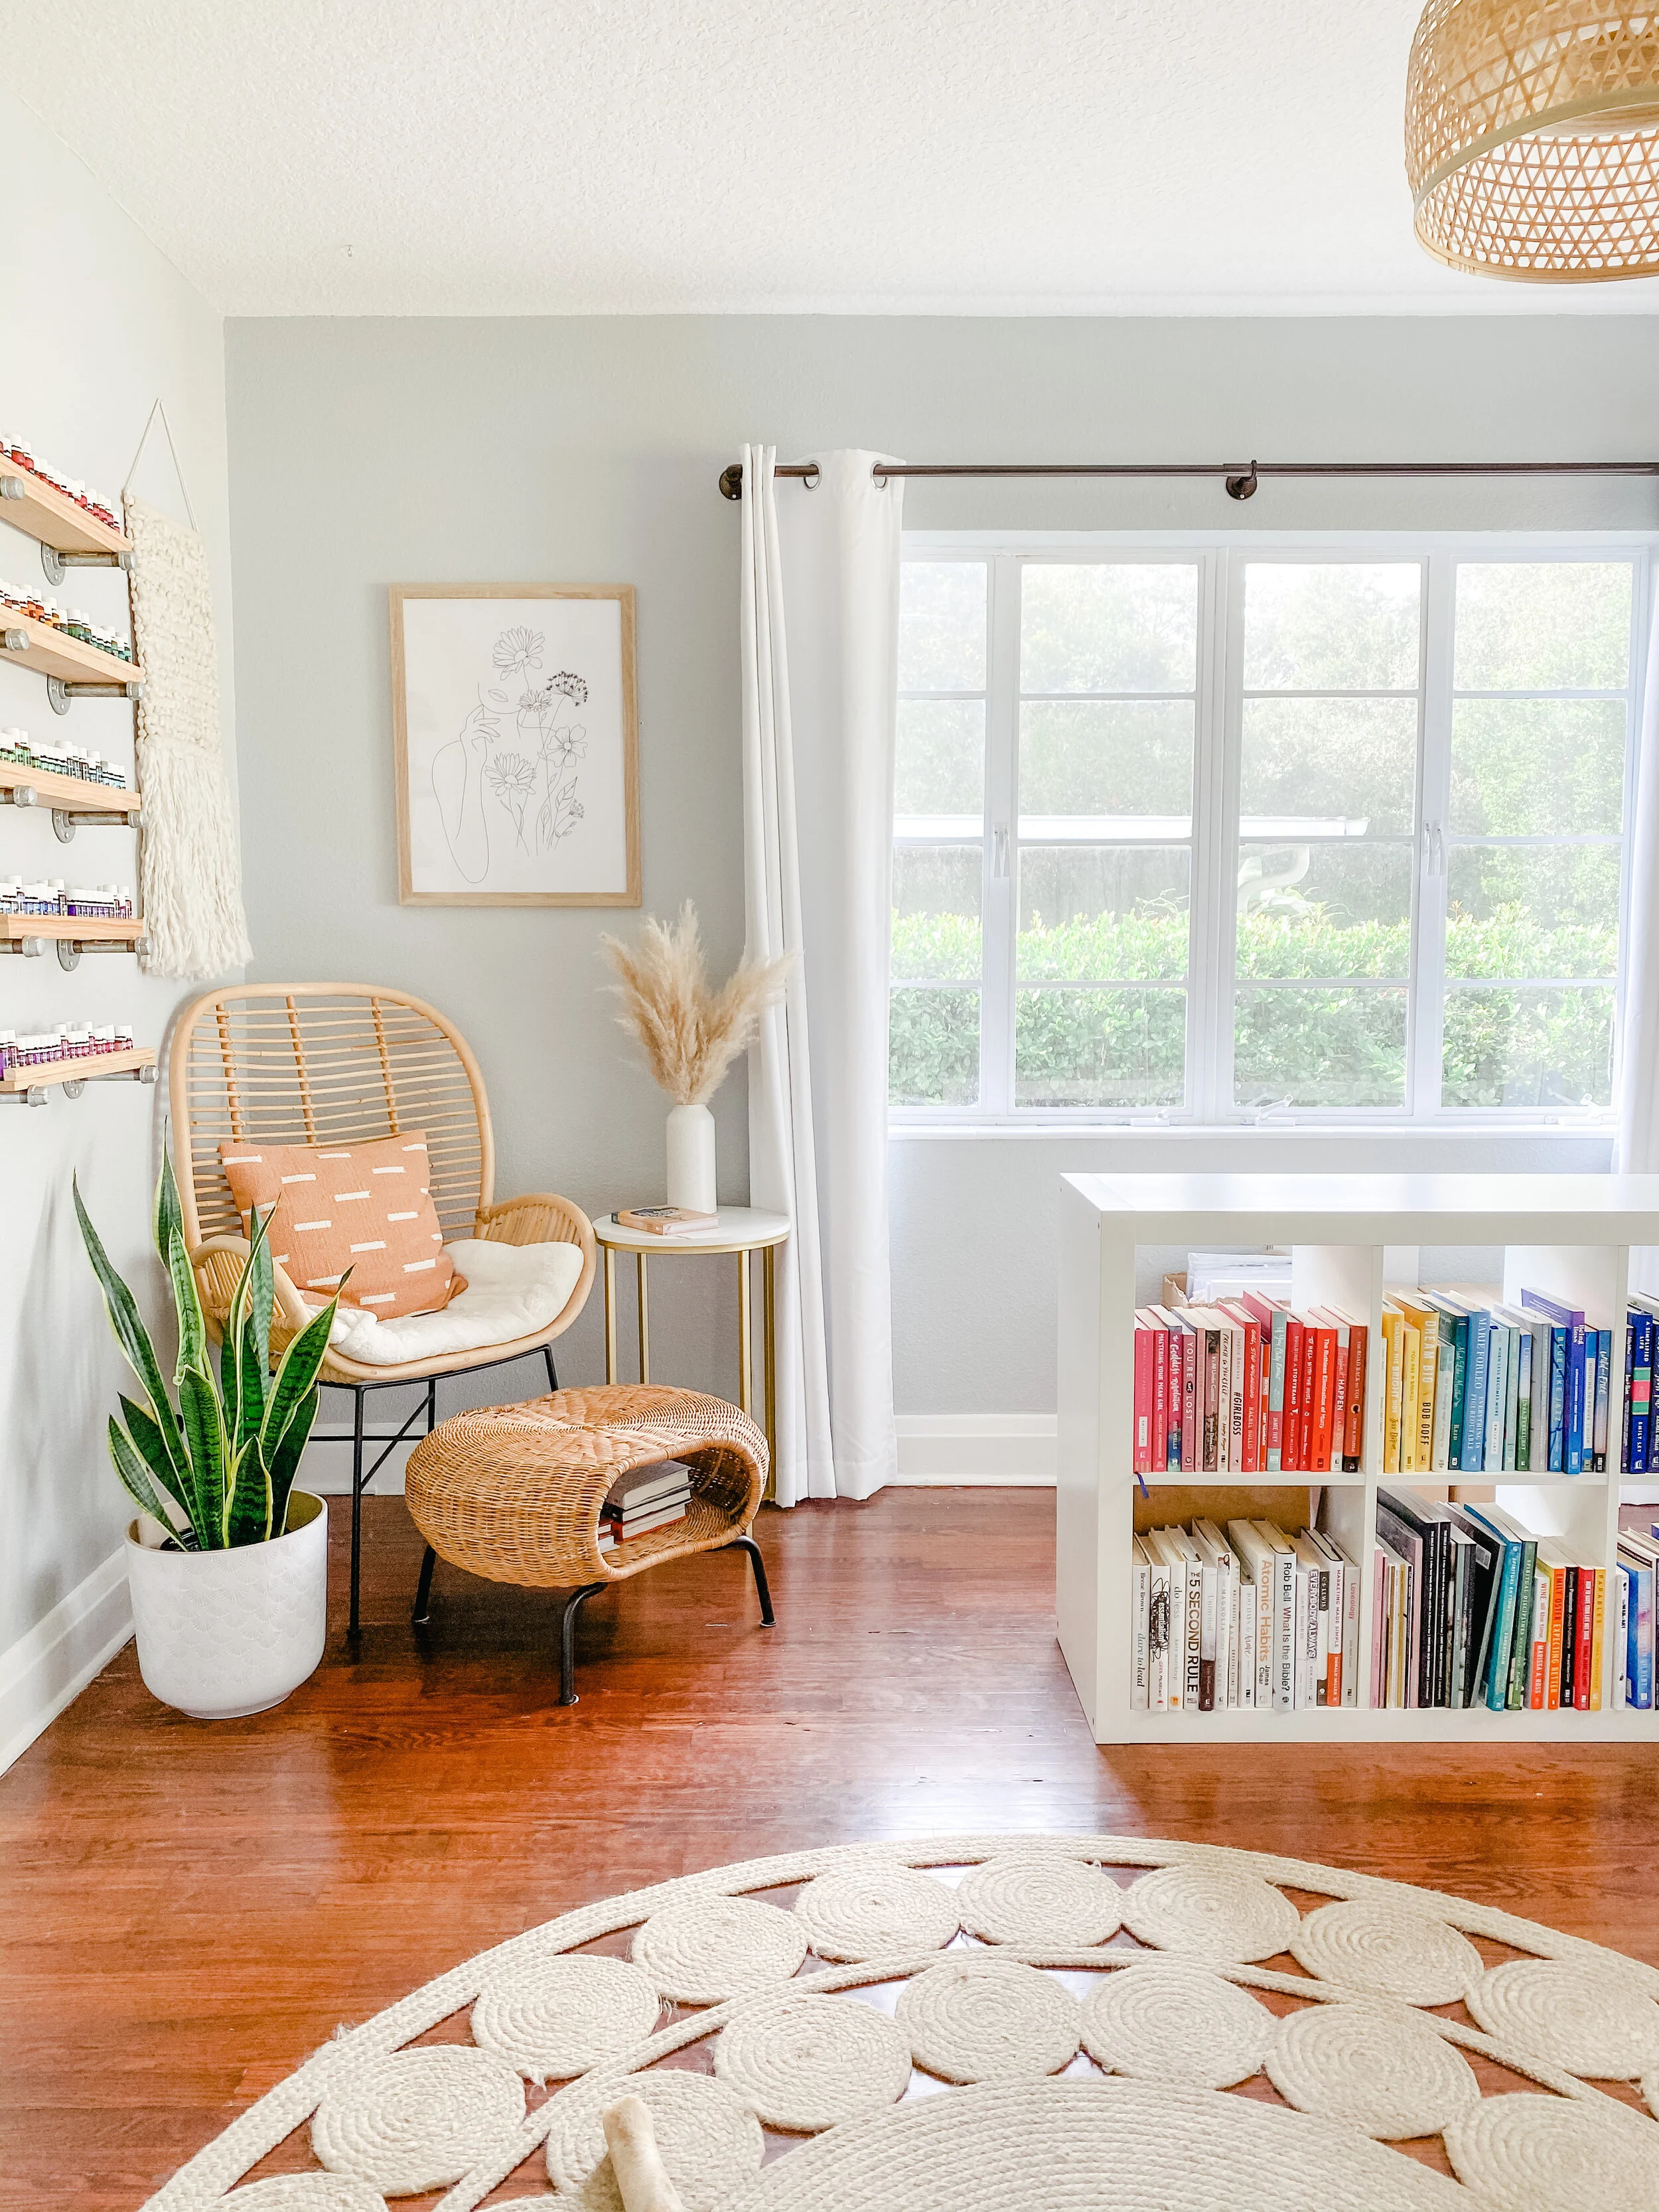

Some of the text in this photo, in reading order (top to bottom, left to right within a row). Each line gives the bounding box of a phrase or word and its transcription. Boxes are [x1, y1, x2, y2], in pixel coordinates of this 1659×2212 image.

[1422, 1321, 1435, 1383] DREAM BIG
[1475, 1317, 1486, 1389] MARIE FORLEO
[1600, 1351, 1609, 1368] Wild
[1599, 1376, 1607, 1394] Free
[1422, 1402, 1431, 1419] BOB
[1467, 1394, 1477, 1451] FIGUREOUTABLE
[1523, 1560, 1532, 1593] SPIRITUAL
[1555, 1574, 1563, 1595] EMILY
[1173, 1587, 1183, 1619] do less
[1260, 1560, 1273, 1661] Atomic Habits
[1283, 1607, 1291, 1631] What
[1188, 1591, 1200, 1651] SECOND
[1244, 1635, 1253, 1657] brave
[1551, 1624, 1561, 1663] EXPECTING
[1187, 1655, 1198, 1692] RULE
[1281, 1663, 1290, 1691] Bible?
